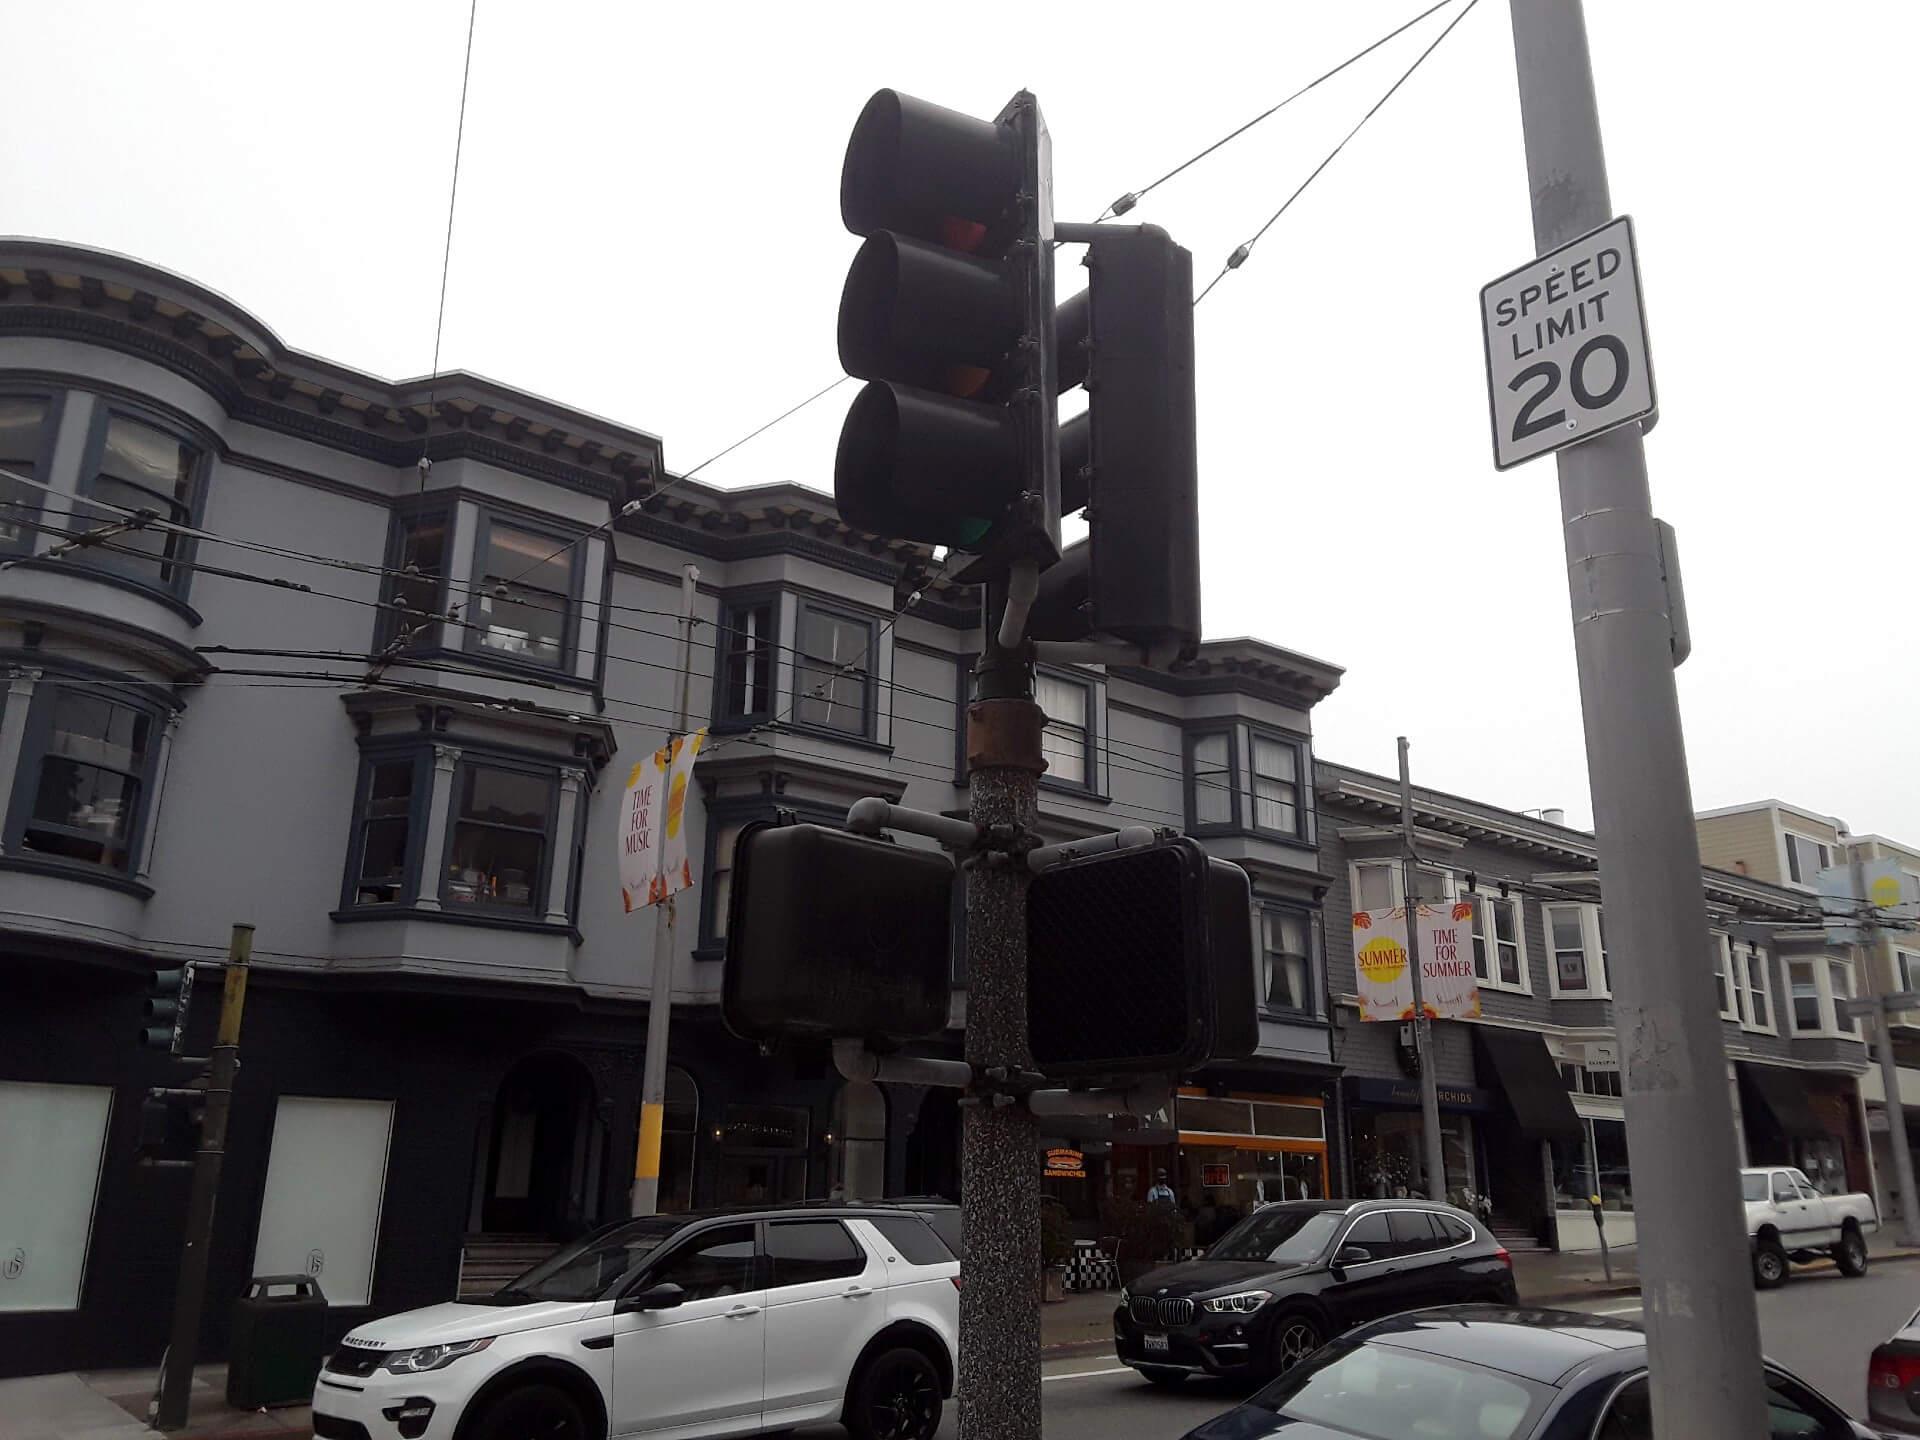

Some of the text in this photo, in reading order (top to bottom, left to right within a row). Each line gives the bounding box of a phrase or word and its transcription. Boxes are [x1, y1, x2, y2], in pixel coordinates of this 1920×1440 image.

[1496, 248, 1622, 327] SPEED
[1512, 290, 1610, 360] LIMIT
[1507, 334, 1630, 442] 20
[632, 785, 653, 810] TIME
[631, 808, 649, 831] FOR
[626, 829, 653, 855] MUSIC
[1432, 928, 1459, 944] TIME
[1357, 948, 1408, 967] SUMMER
[1435, 945, 1457, 960] FOR
[1423, 961, 1472, 978] SUMMER
[1437, 1088, 1473, 1104] RCHIDS
